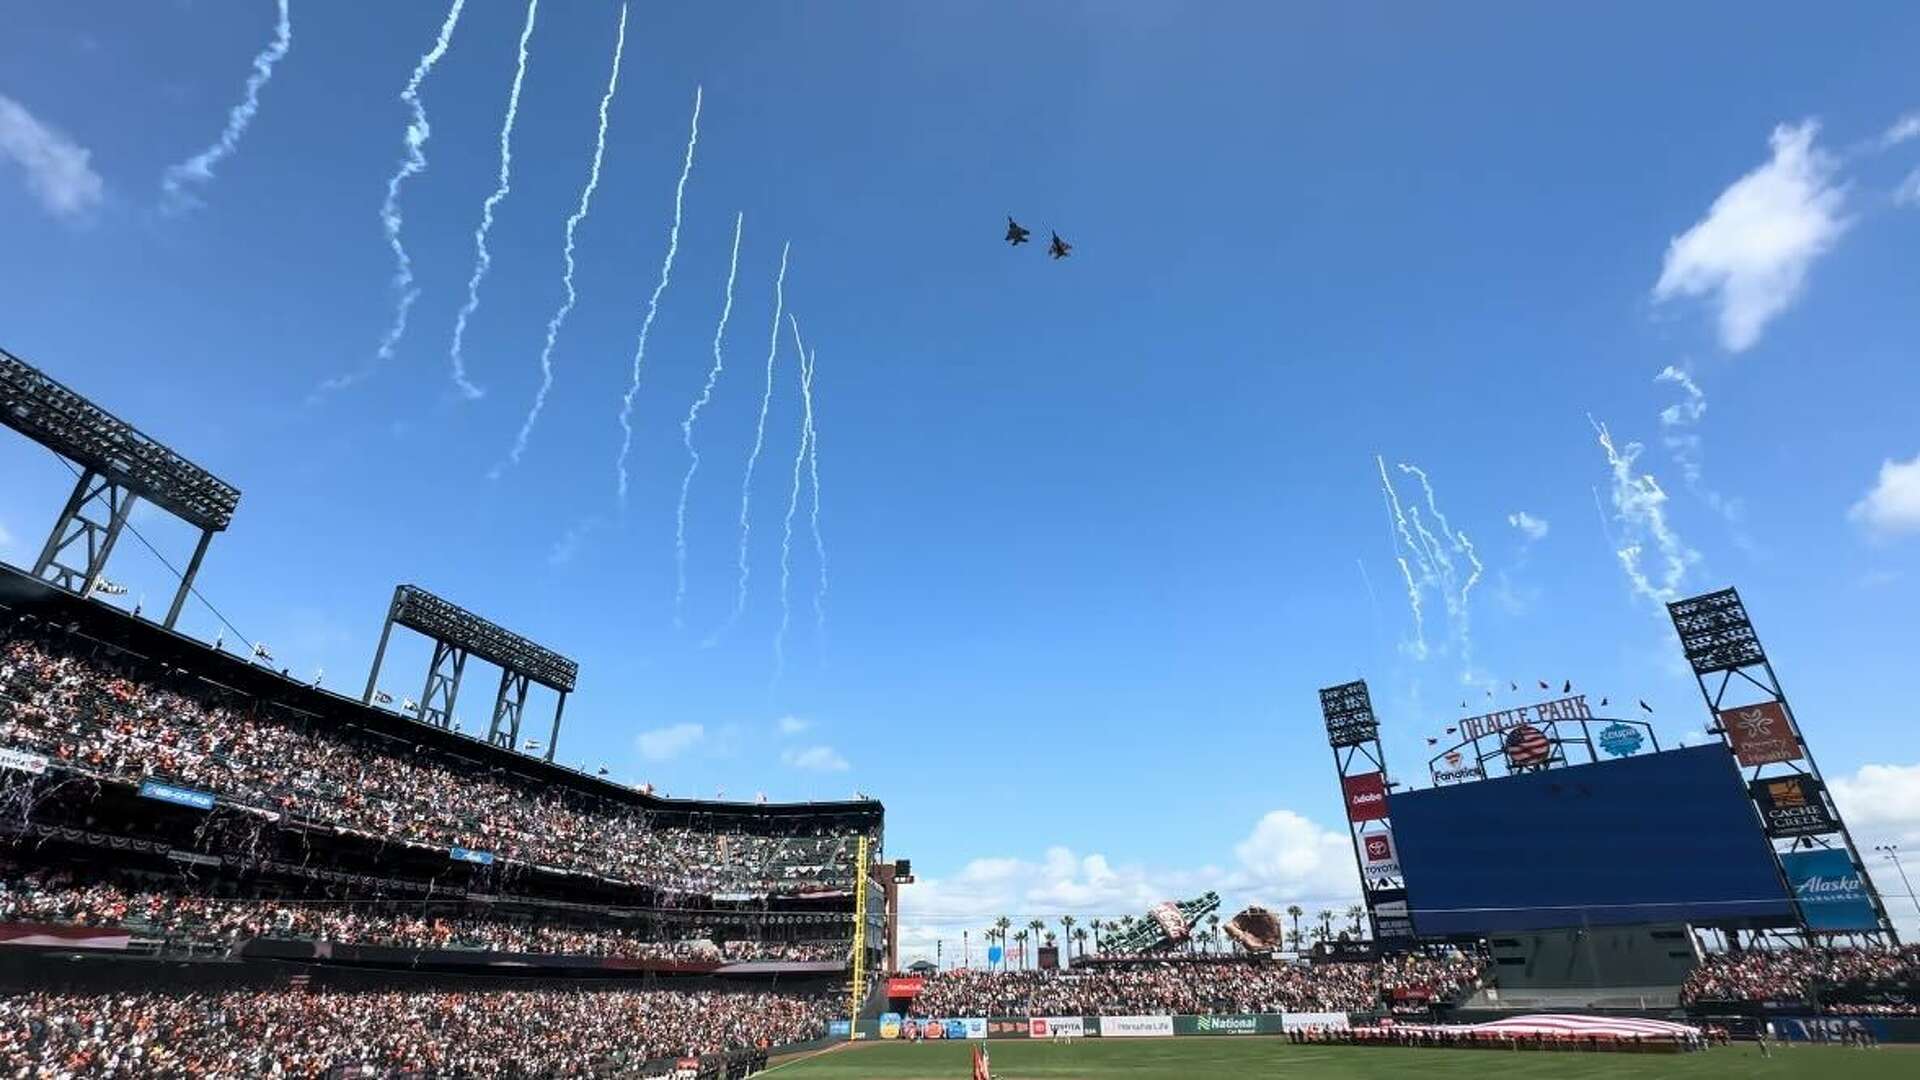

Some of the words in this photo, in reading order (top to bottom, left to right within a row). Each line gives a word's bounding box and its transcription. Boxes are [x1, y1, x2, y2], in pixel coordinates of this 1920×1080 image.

[1537, 695, 1593, 721] PARK
[1353, 793, 1382, 804] Adobe
[1768, 805, 1820, 818] CACHE
[1774, 815, 1821, 828] CREEK
[1365, 864, 1399, 874] TOYOTA
[1797, 875, 1859, 893] Alaska
[1211, 1017, 1257, 1029] National
